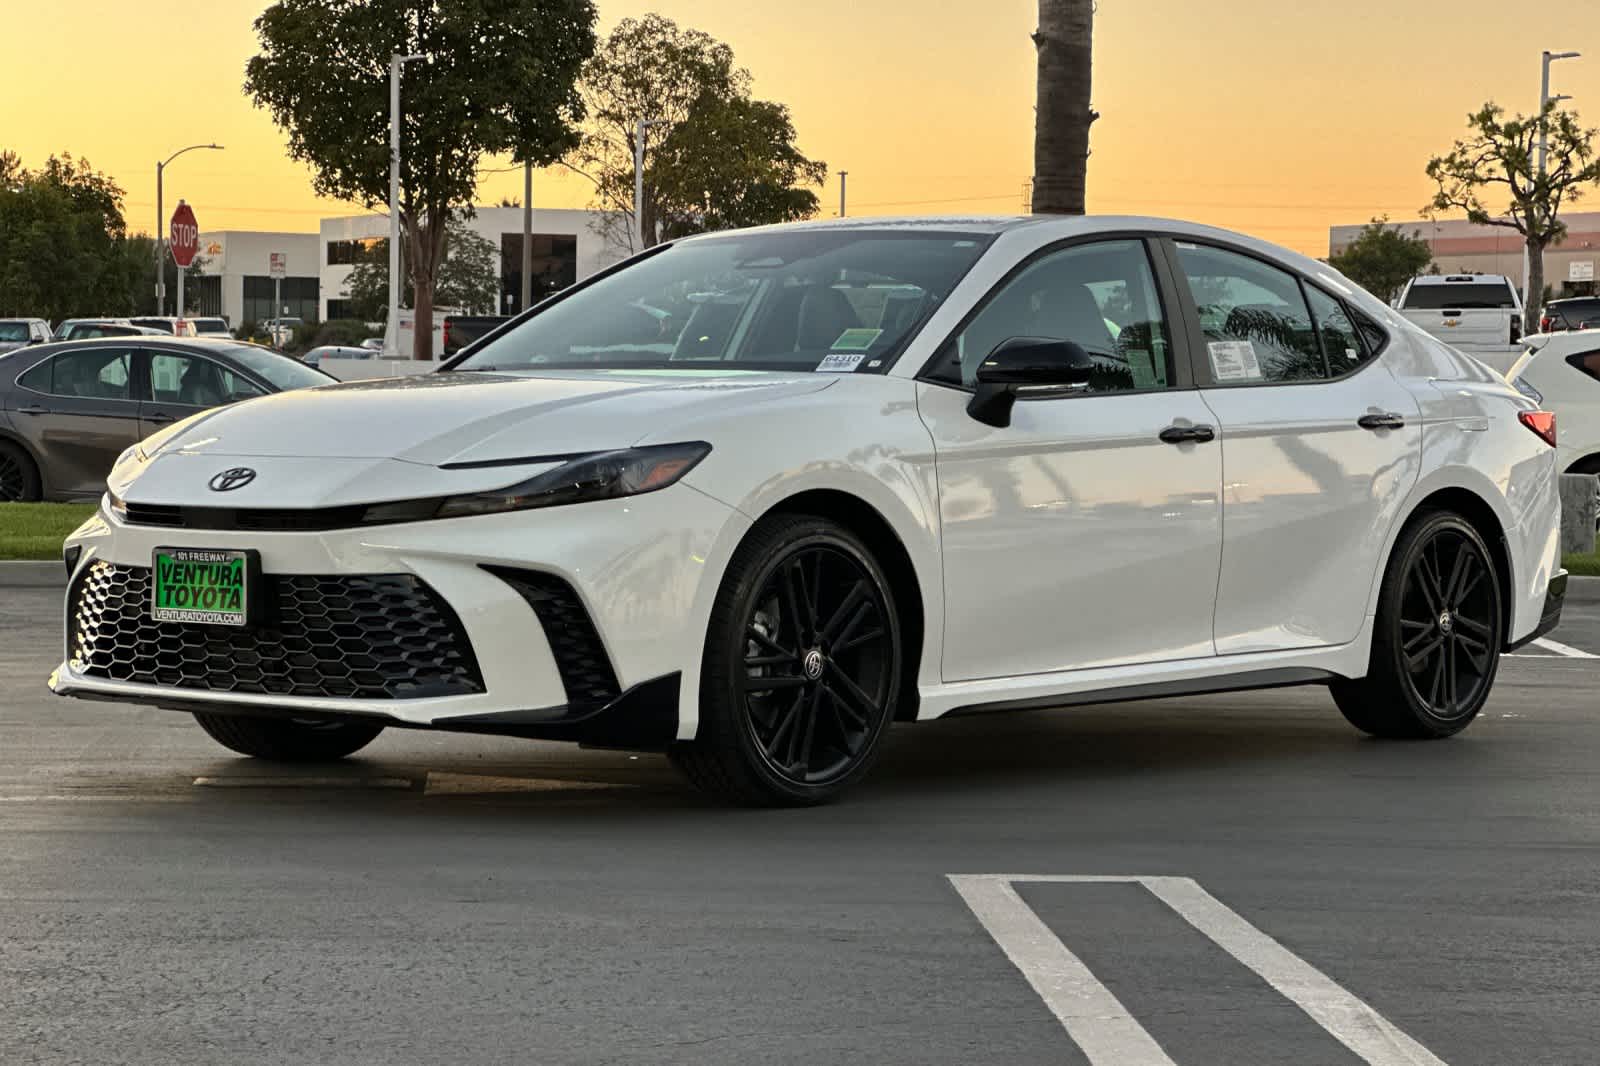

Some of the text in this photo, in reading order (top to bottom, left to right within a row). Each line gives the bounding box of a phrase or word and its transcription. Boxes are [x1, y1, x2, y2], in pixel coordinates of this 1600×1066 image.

[171, 223, 197, 248] STOP
[177, 552, 226, 561] 101 FREEWAY
[161, 563, 243, 586] VENTURA
[163, 585, 241, 609] TOYOTA
[156, 610, 242, 623] VENTURATOYOTA.COM
